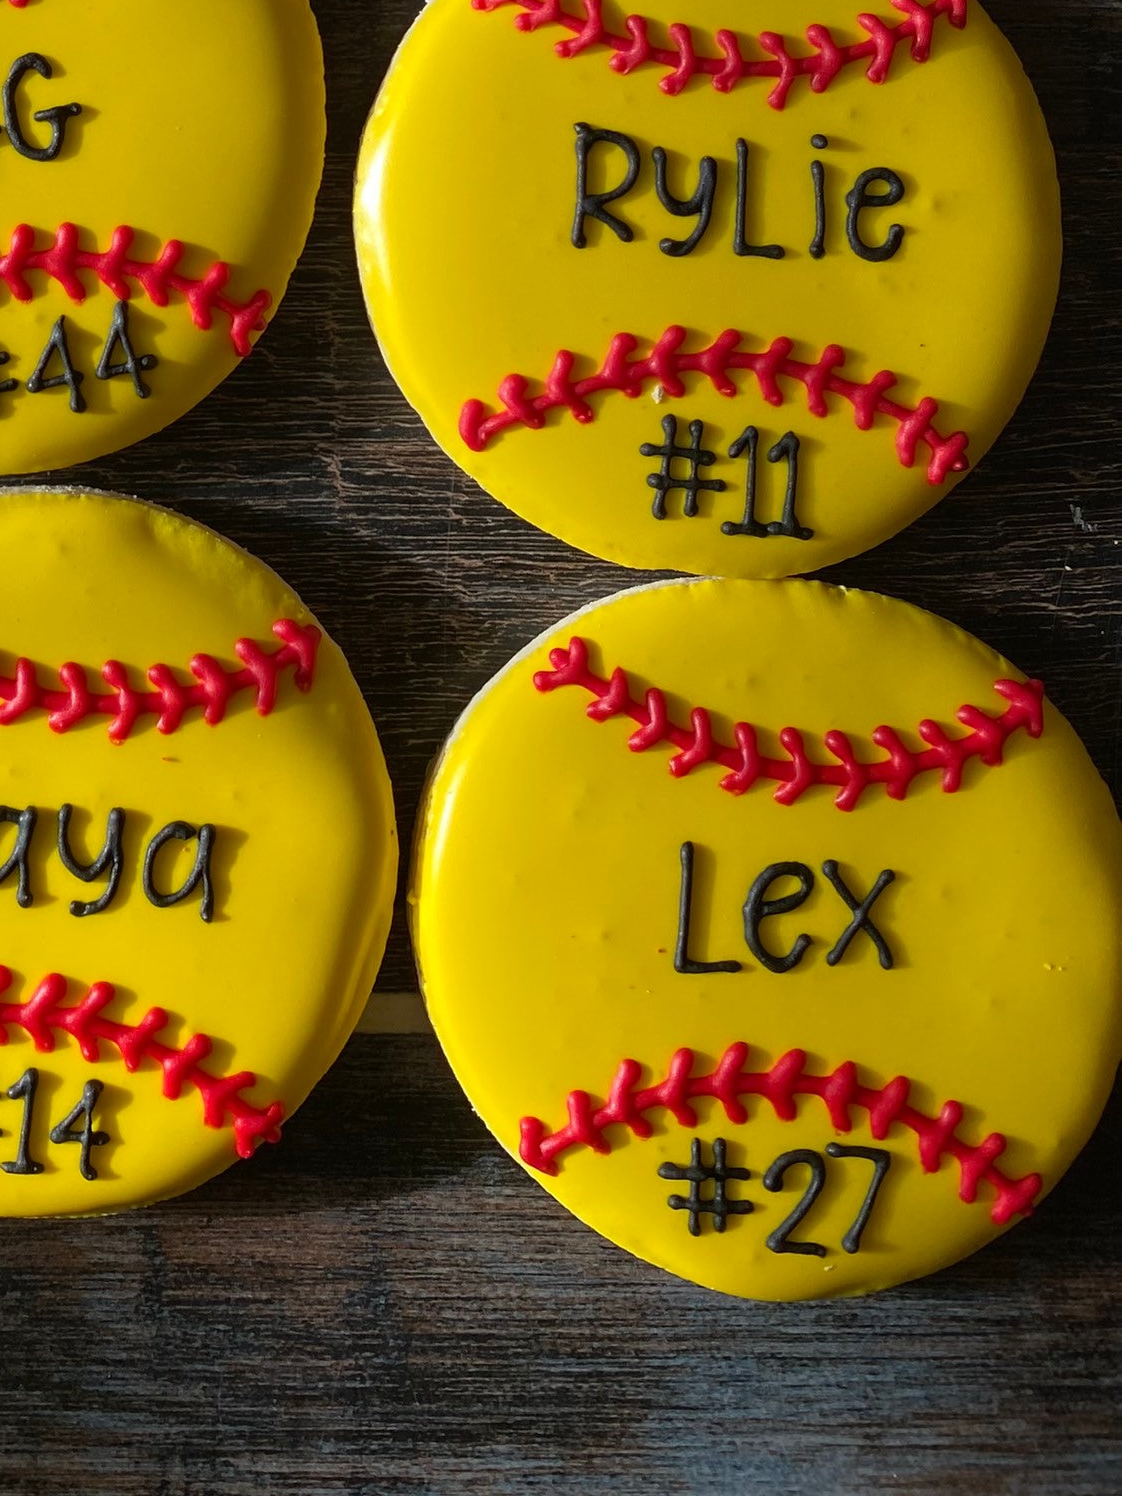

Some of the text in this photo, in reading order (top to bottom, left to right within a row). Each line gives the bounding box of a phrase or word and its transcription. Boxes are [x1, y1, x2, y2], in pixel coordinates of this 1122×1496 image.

[639, 412, 818, 541] #11
[673, 840, 899, 975] Lex
[657, 1136, 897, 1259] #27
